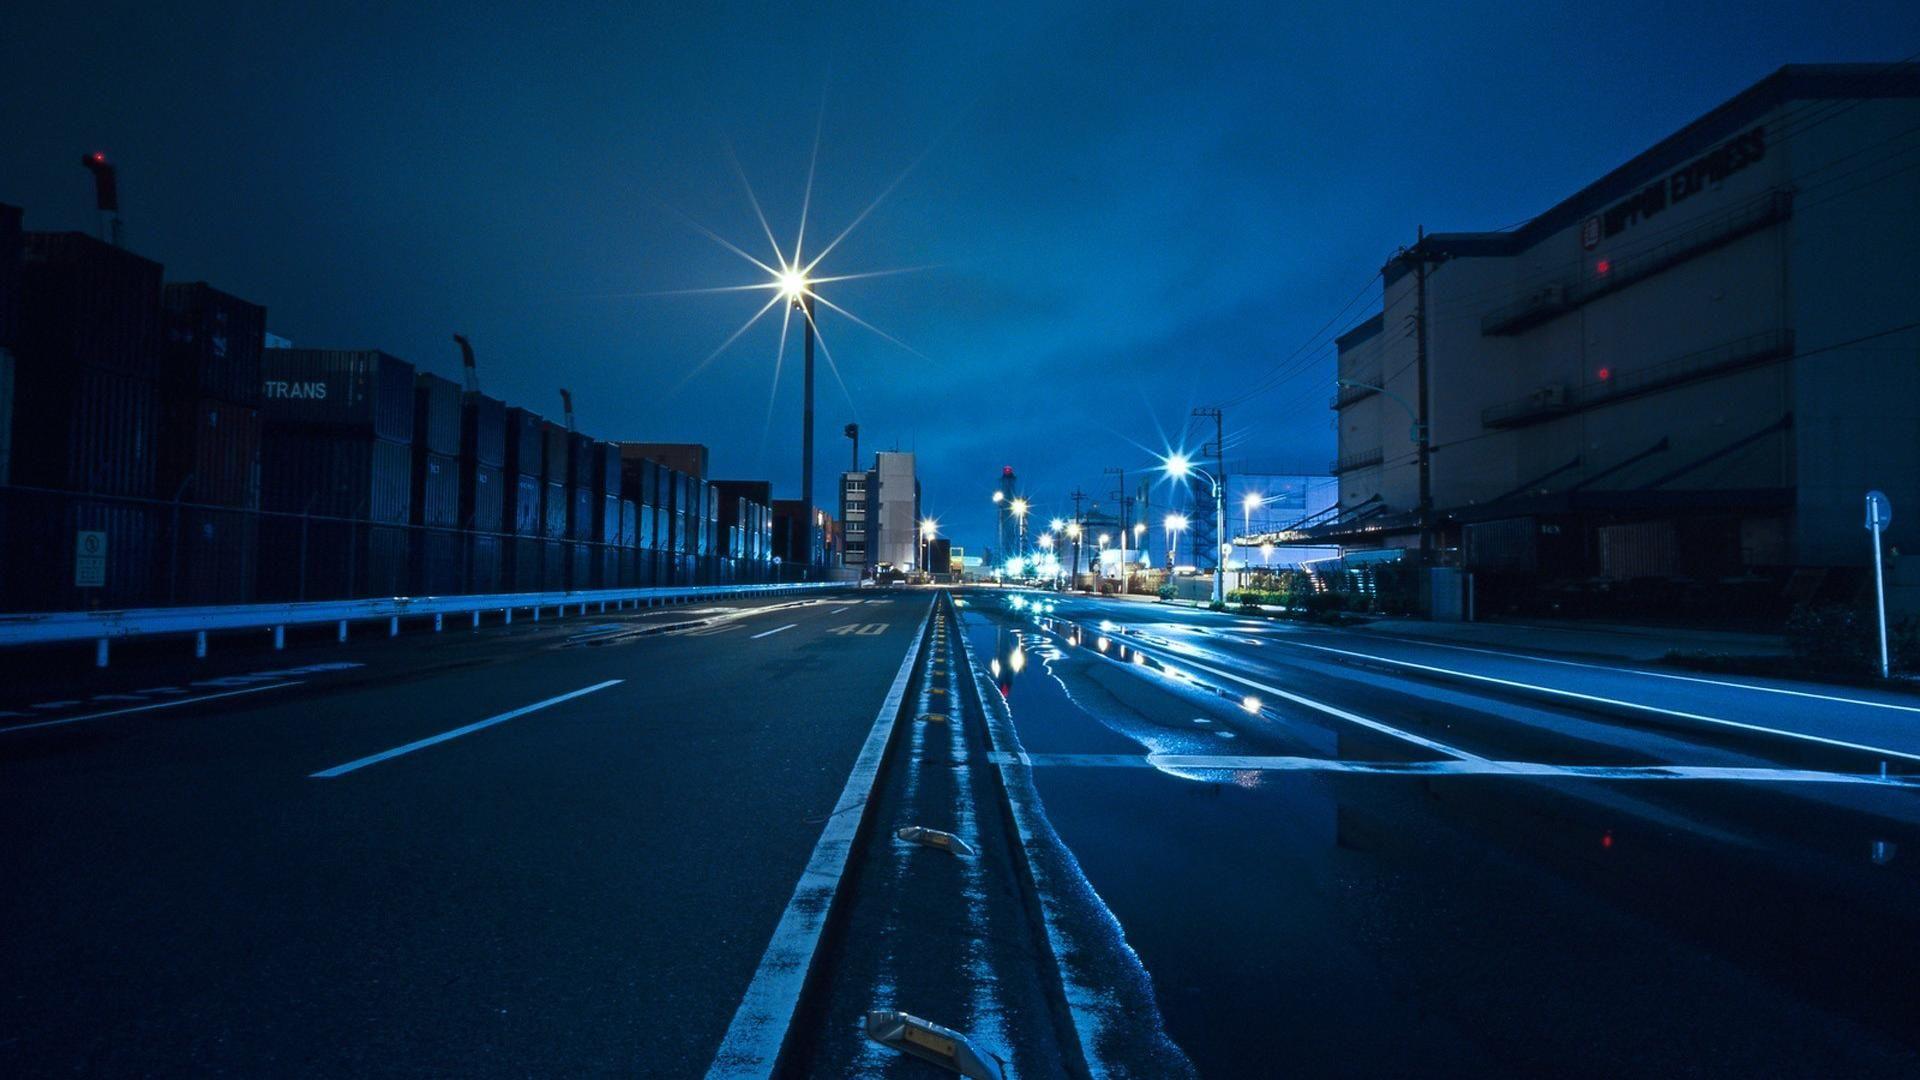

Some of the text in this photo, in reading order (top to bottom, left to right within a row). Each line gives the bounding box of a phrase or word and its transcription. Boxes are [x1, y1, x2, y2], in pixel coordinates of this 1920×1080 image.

[1604, 178, 1666, 239] NIPPON
[1672, 126, 1766, 204] EXPRESS
[265, 381, 328, 400] TRANS
[826, 624, 890, 635] 40
